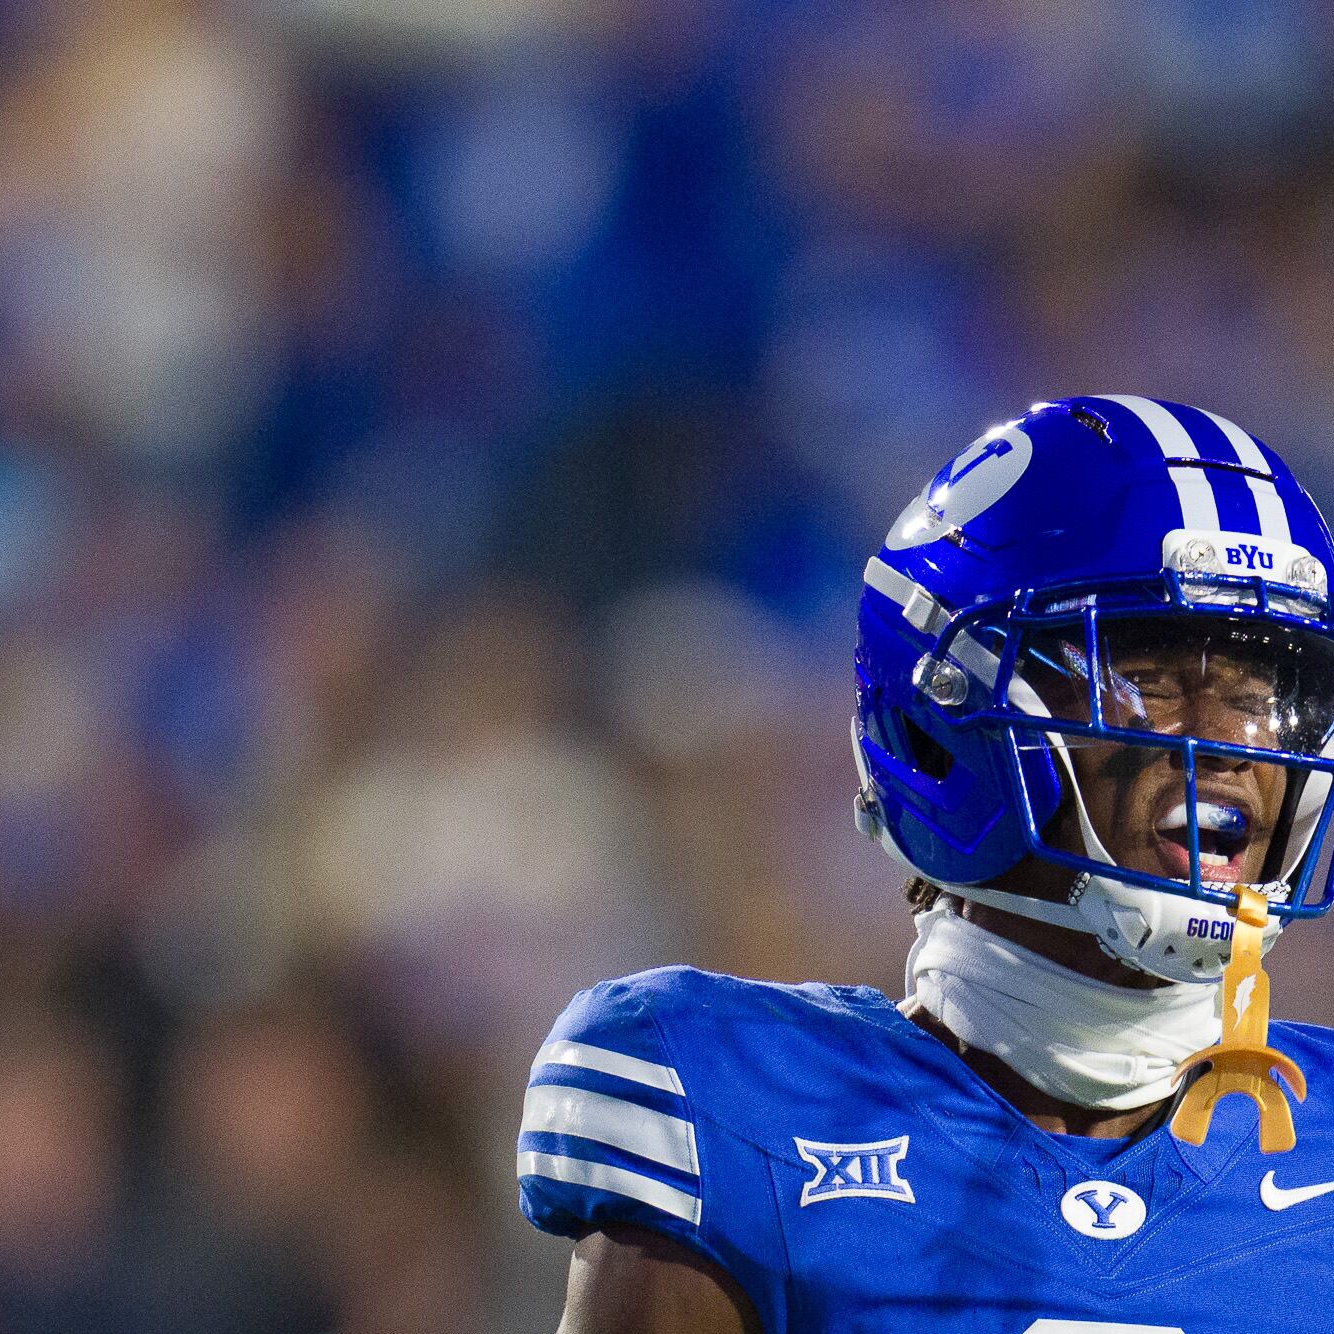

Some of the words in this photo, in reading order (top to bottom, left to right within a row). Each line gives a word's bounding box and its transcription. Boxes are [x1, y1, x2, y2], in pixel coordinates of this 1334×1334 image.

[1225, 544, 1274, 570] BYU
[1187, 917, 1208, 939] GO
[1210, 920, 1235, 942] CO
[803, 1145, 908, 1197] XII
[1074, 1189, 1128, 1229] Y
